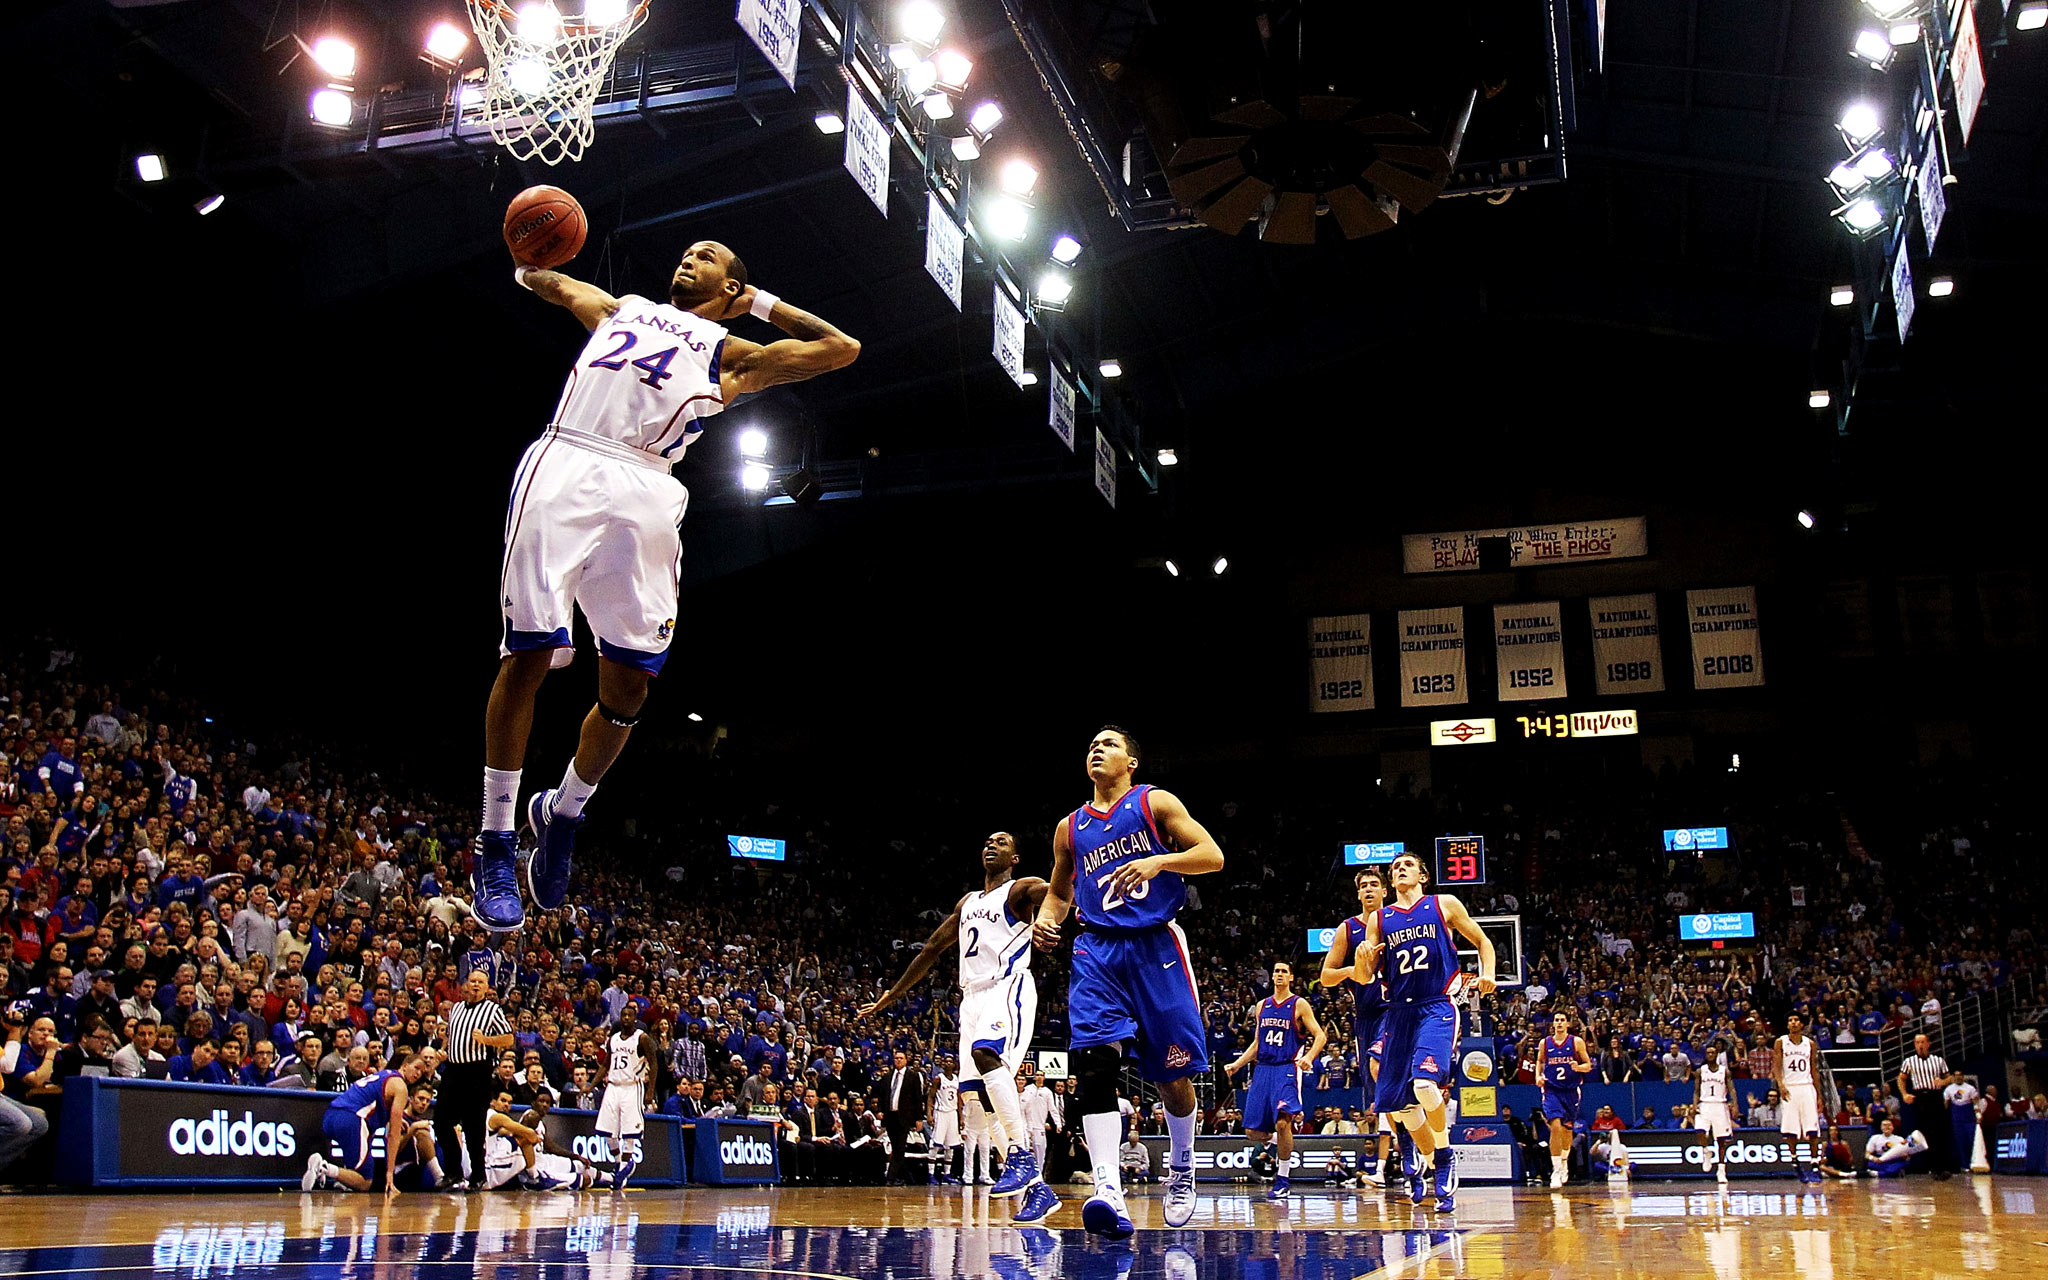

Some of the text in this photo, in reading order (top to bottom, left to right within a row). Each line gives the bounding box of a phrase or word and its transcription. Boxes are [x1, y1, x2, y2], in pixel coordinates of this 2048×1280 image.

[759, 16, 780, 61] 1991
[510, 210, 556, 244] Wilson
[589, 331, 679, 391] 24
[1527, 529, 1558, 541] Who
[1598, 609, 1651, 623] NATIONAL
[1696, 603, 1750, 617] NATIONAL
[1406, 623, 1457, 636] NATIONAL
[1502, 616, 1554, 630] NATIONAL
[1691, 618, 1758, 633] CHAMPIONS
[1314, 630, 1365, 643] NATIONAL
[1497, 631, 1560, 646] CHAMPIONS
[1594, 624, 1658, 639] CHAMPIONS
[1311, 645, 1370, 658] CHAMPIONS
[1401, 638, 1464, 652] CHAMPIONS
[1607, 661, 1651, 681] 1988
[1703, 655, 1753, 675] 2008
[1412, 674, 1455, 694] 1923
[1510, 668, 1553, 688] 1952
[1320, 680, 1363, 700] 1922
[1516, 714, 1569, 738] 7:43
[1083, 830, 1152, 877] AMERICAN
[1450, 842, 1478, 855] 2:42
[1447, 856, 1477, 880] 33
[1712, 914, 1742, 923] Capitol
[1713, 921, 1743, 931] Federal
[965, 927, 979, 958] 2
[1387, 924, 1436, 950] AMERICAN
[1396, 945, 1429, 975] 22
[1260, 1017, 1291, 1030] AMERICAN
[1265, 1030, 1284, 1047] 44
[613, 1055, 628, 1071] 15
[1788, 1059, 1806, 1072] 40
[1556, 1067, 1566, 1080] 2
[948, 1091, 955, 1101] 3
[1710, 1086, 1715, 1096] 1
[168, 1109, 296, 1157] adidas
[573, 1134, 643, 1164] adis
[720, 1135, 773, 1165] adidas
[1685, 1139, 1777, 1164] addas
[1216, 1147, 1301, 1169] ads
